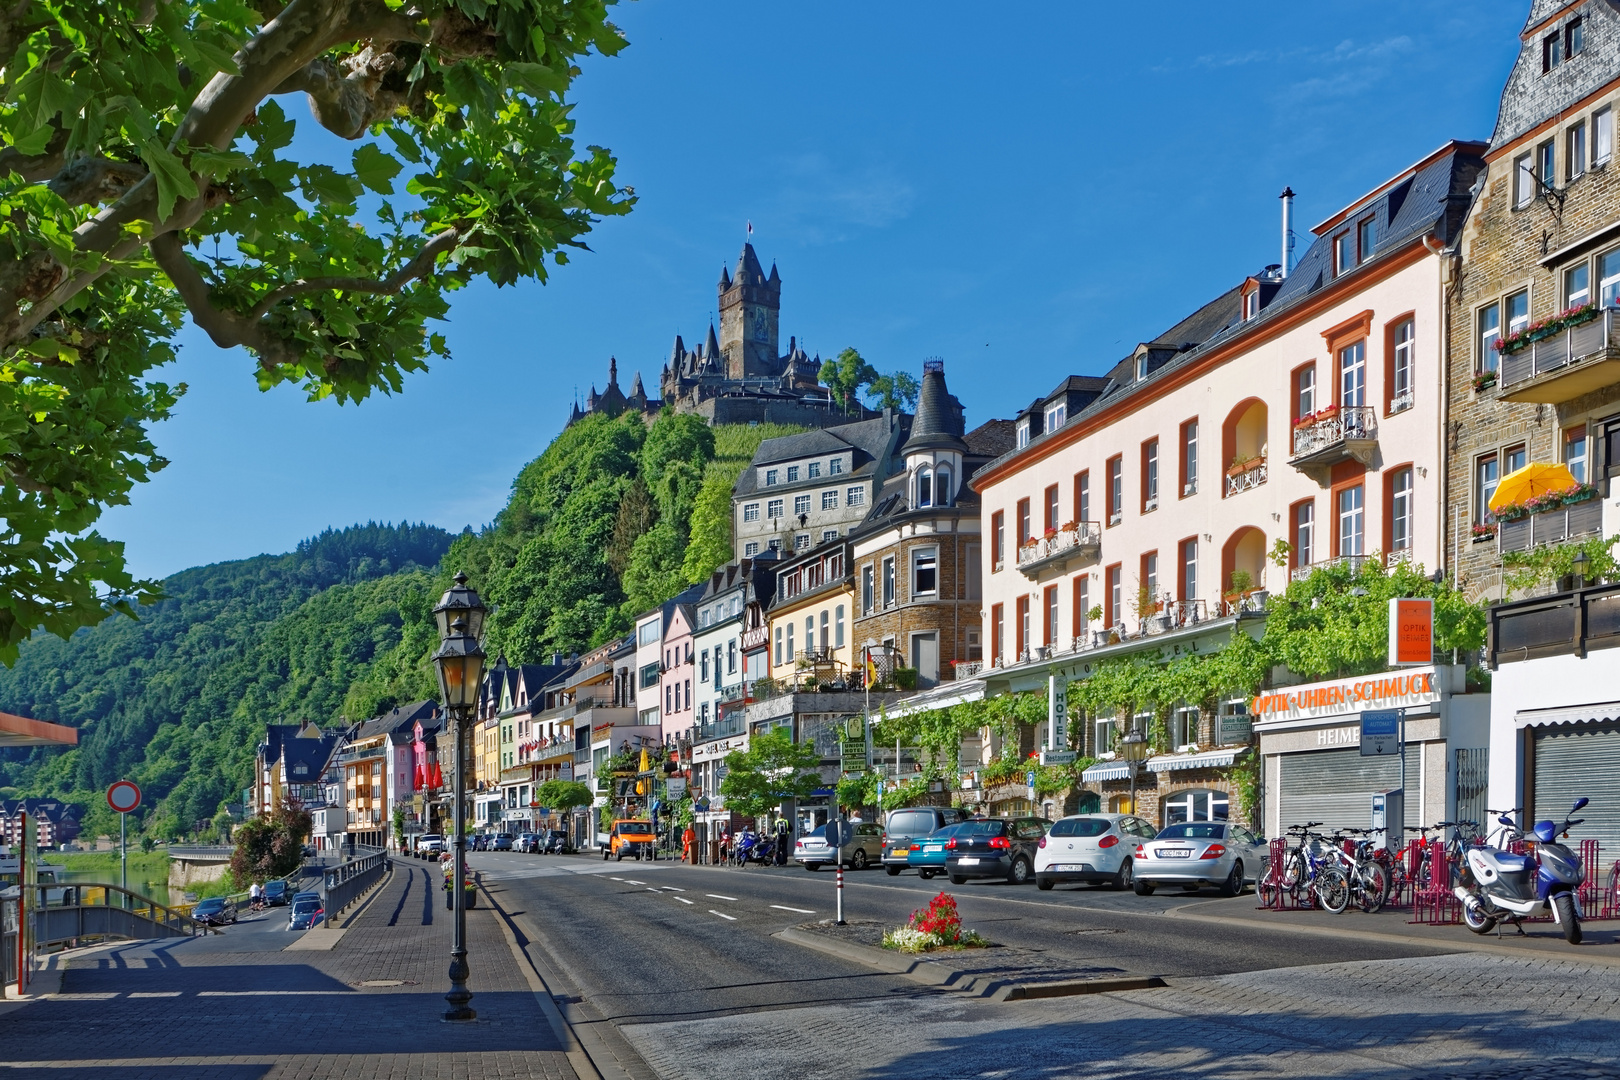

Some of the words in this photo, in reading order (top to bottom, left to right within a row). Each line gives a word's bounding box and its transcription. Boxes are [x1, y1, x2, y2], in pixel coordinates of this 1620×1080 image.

[1403, 624, 1426, 632] OPTIK
[1400, 634, 1429, 642] HEIMES
[1252, 693, 1290, 715] OPTIK
[1297, 685, 1345, 710] UHREN
[1353, 673, 1433, 702] SCHMUCK
[1055, 693, 1064, 746] HOTEL
[1317, 727, 1361, 746] HEIME
[1045, 753, 1074, 763] Restaurant
